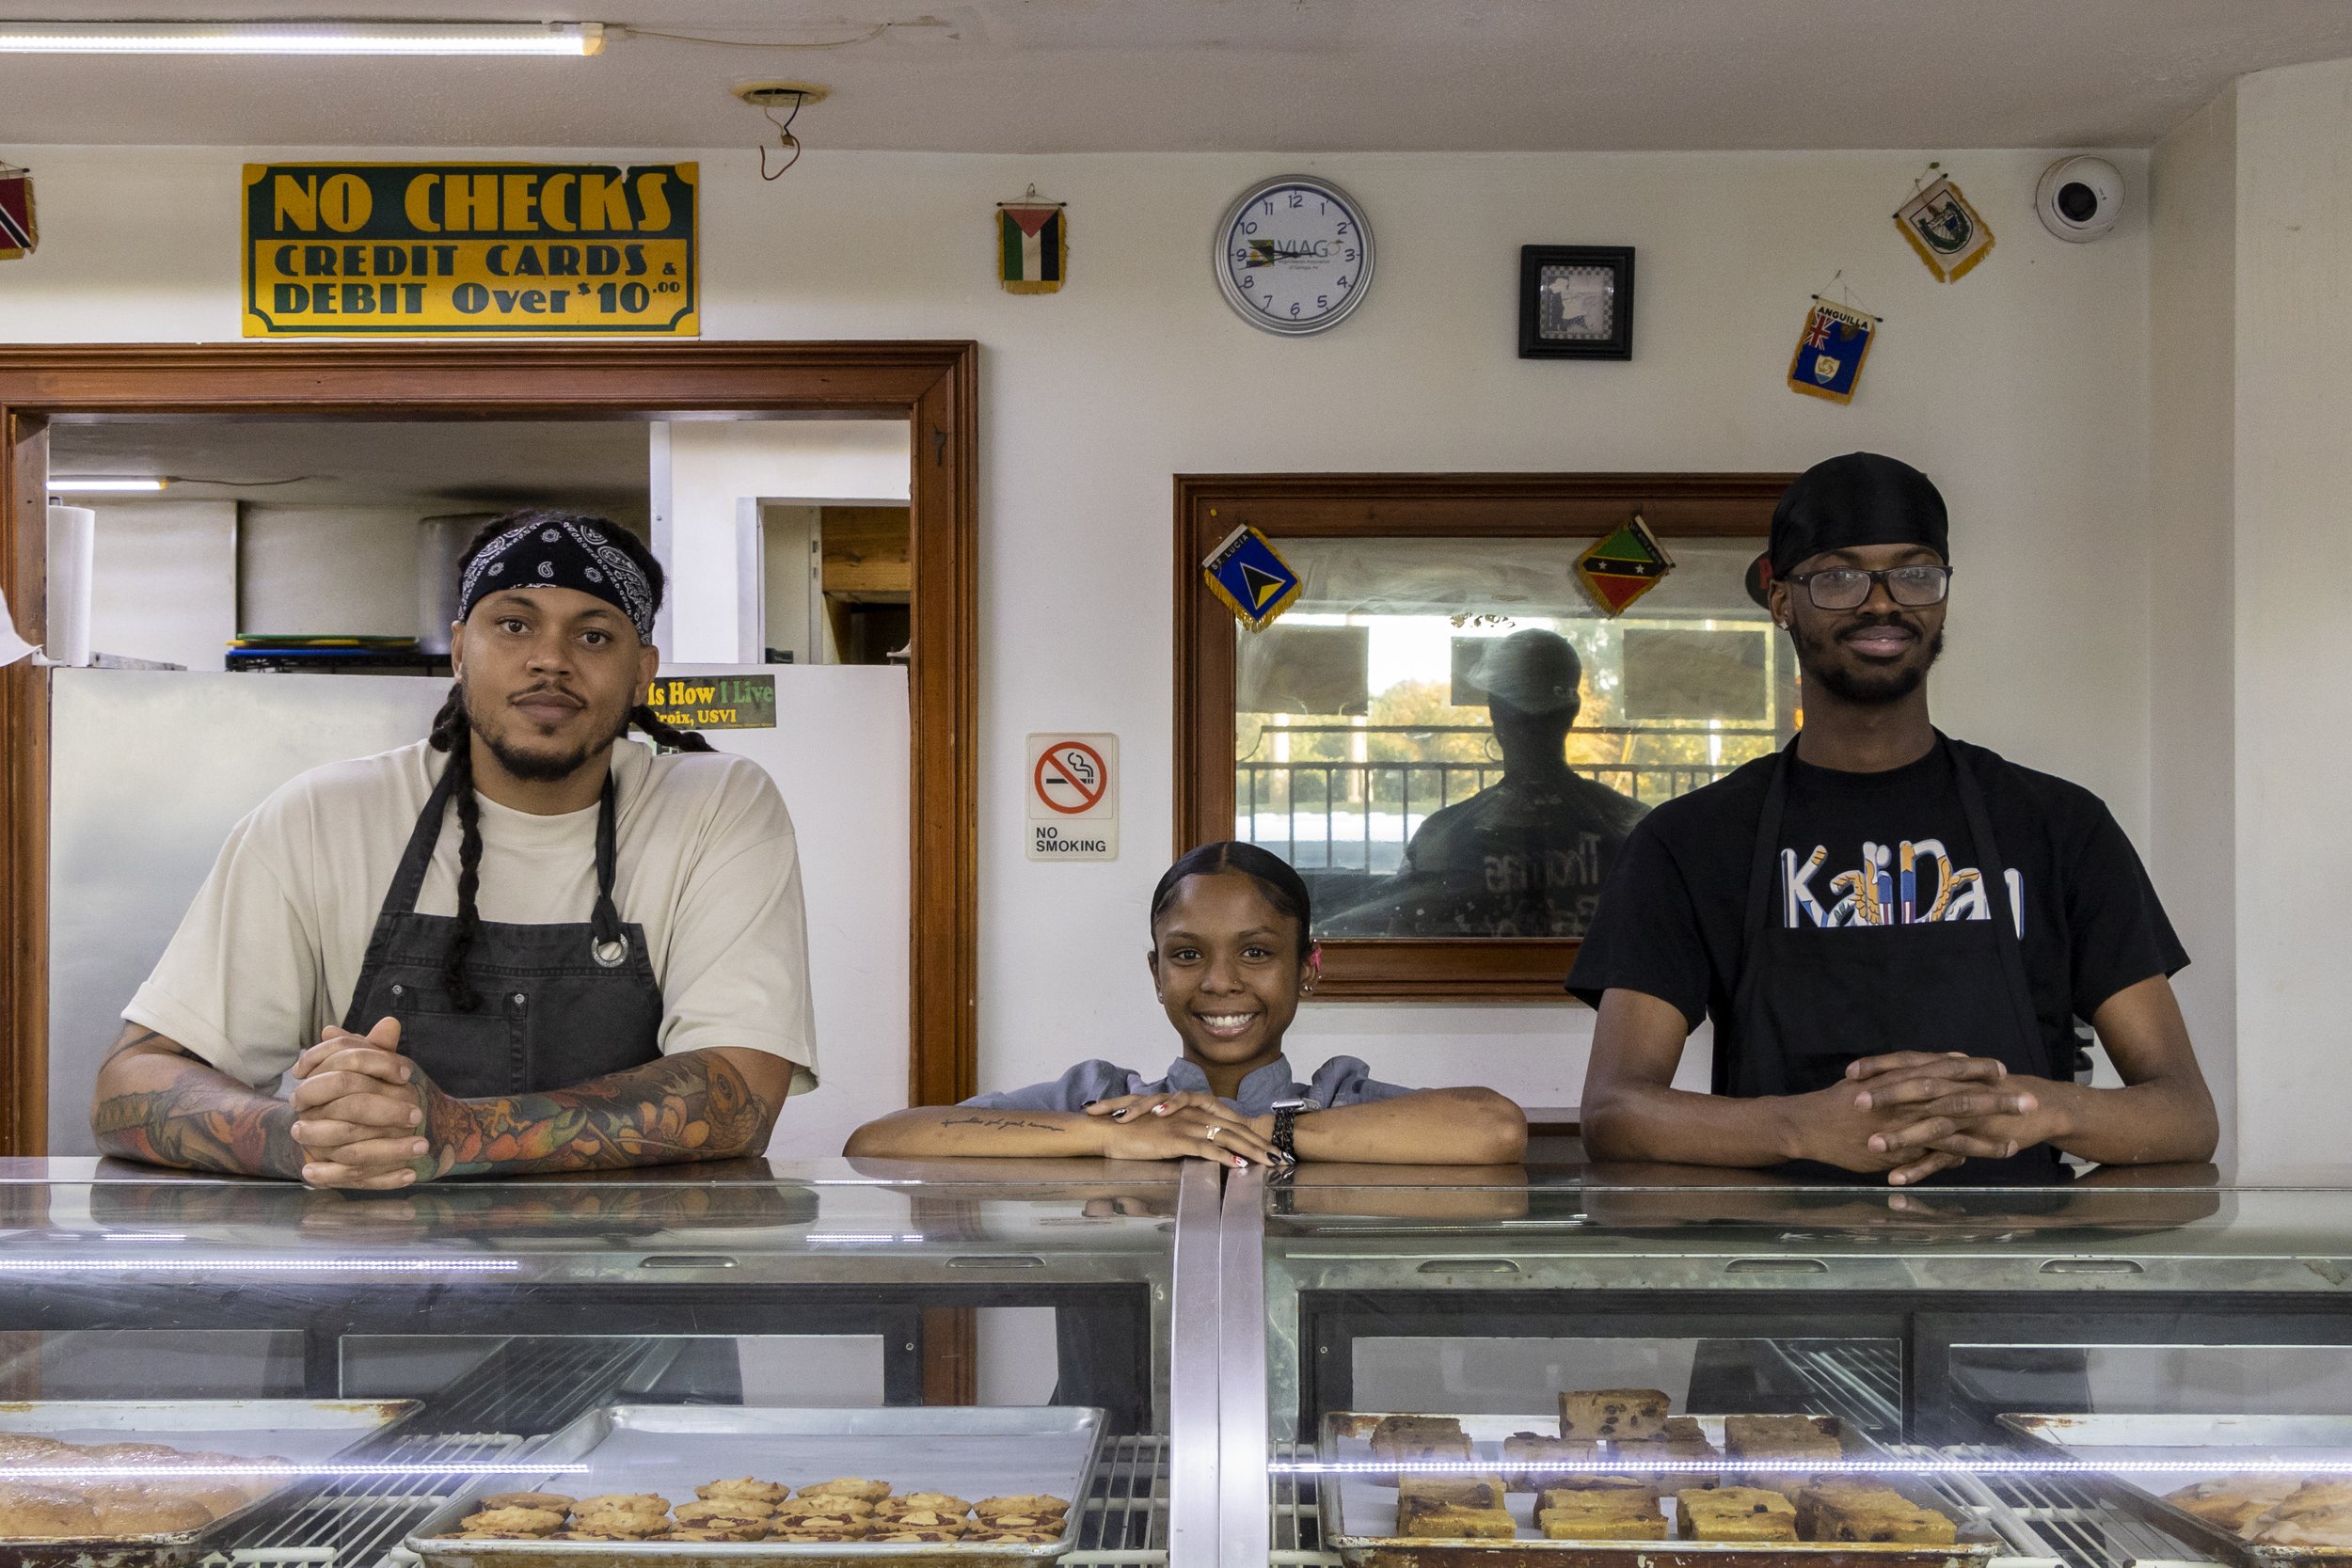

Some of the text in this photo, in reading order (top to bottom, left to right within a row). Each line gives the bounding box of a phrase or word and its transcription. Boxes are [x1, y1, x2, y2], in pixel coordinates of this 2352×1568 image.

[274, 172, 673, 232] NO CHECKS
[1288, 195, 1303, 208] 12
[1264, 202, 1273, 215] 11
[1321, 202, 1326, 215] 1
[1240, 222, 1257, 234] 10
[1337, 222, 1347, 234] 2
[273, 245, 459, 277] CREDIT
[485, 244, 648, 277] CARDS
[1236, 248, 1247, 261] 9
[1344, 249, 1355, 261] 3
[1244, 276, 1254, 289] 8
[1337, 276, 1347, 288] 4
[273, 282, 428, 315] DEBIT
[452, 282, 571, 315] Over
[1263, 295, 1273, 308] 7
[1317, 295, 1327, 308] 5
[1290, 303, 1300, 315] 6
[1817, 306, 1868, 330] ANGUILLA
[1224, 534, 1249, 558] LUCIA
[647, 680, 773, 705] Is How I Live
[655, 709, 737, 726] roix, USVI
[1036, 827, 1057, 839] NO
[1036, 840, 1106, 852] SMOKING
